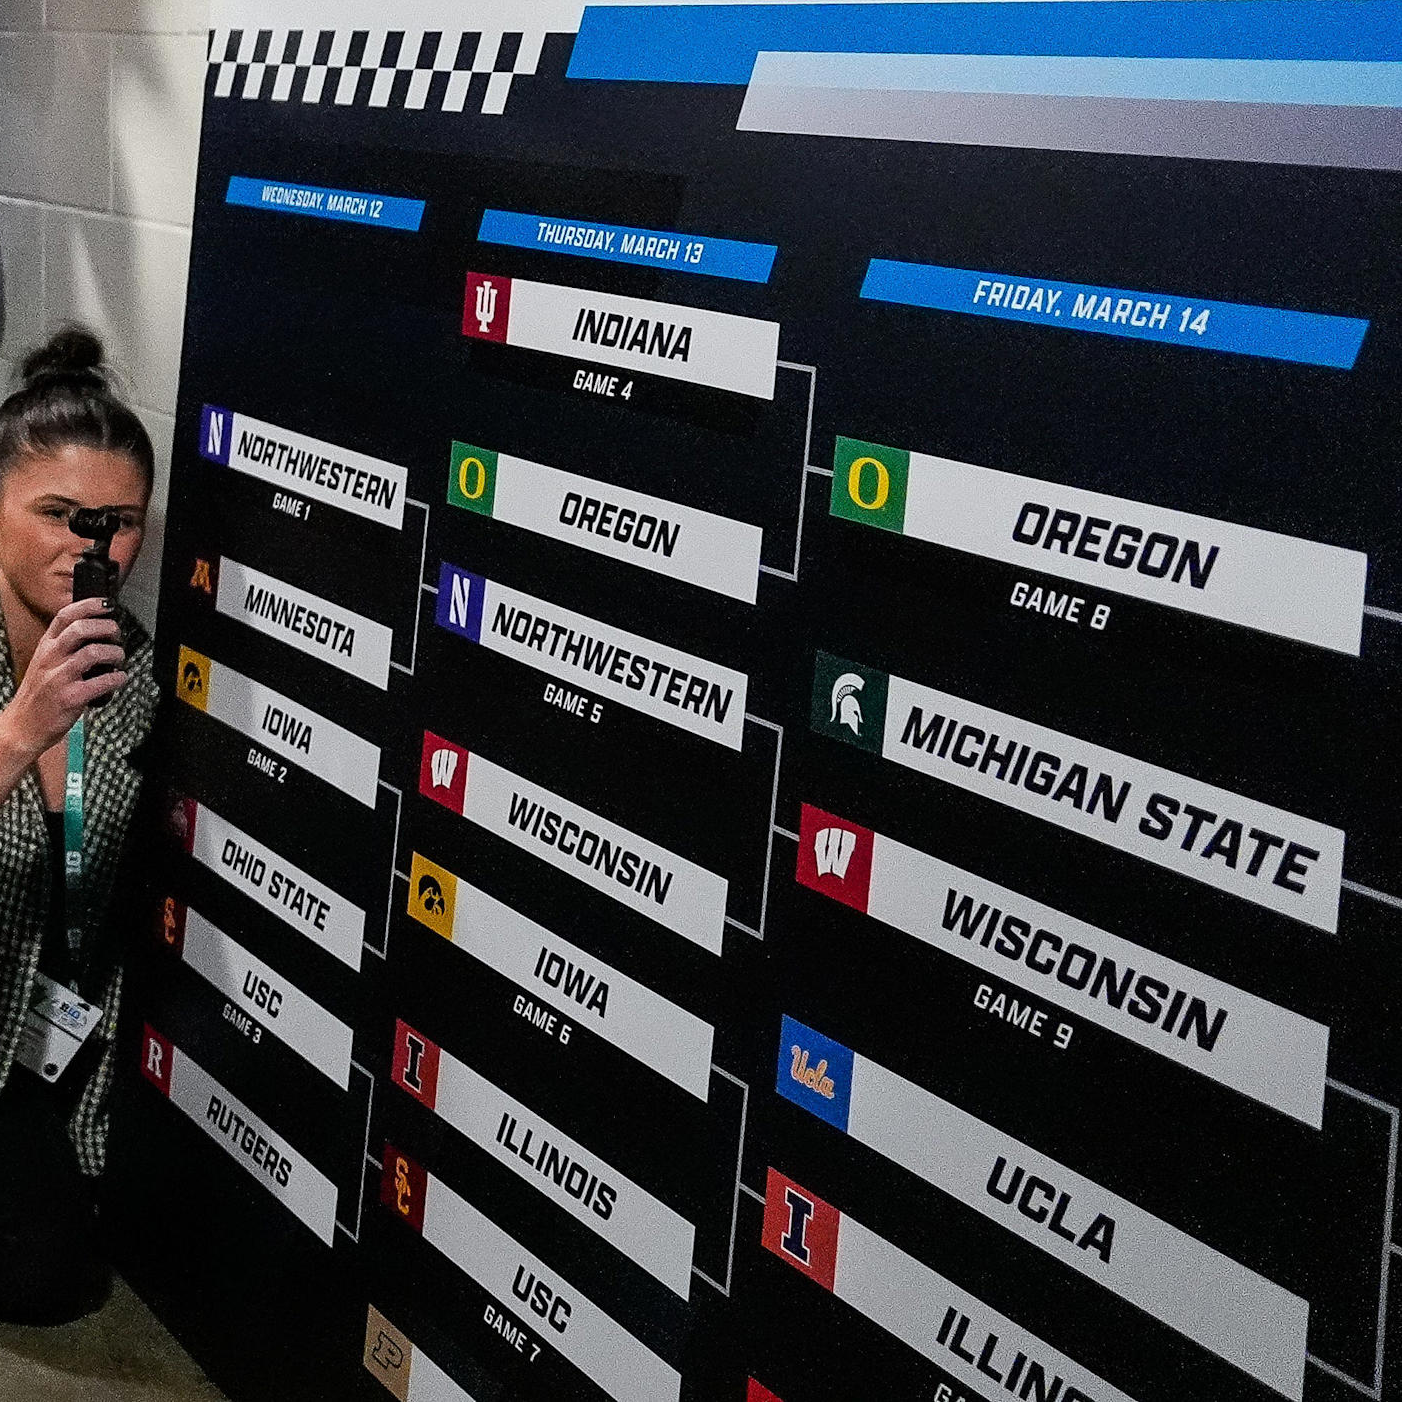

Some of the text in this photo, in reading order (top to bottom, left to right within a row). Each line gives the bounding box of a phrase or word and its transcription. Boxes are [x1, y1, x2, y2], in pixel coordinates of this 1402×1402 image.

[261, 185, 383, 218] WEDNESDAY, MARCH 12
[536, 223, 704, 264] THURSDAY, MARCH 13
[572, 308, 692, 362] INDIANA
[973, 279, 1211, 336] FRIDAY, MARCH 14
[573, 369, 632, 400] GAME 4
[207, 412, 224, 456] N
[237, 430, 397, 511] NORTHWESTERN
[458, 457, 486, 500] O
[847, 457, 890, 510] O
[272, 492, 310, 522] GAME 1
[559, 491, 681, 558] OREGON
[1012, 501, 1220, 590] OREGON
[244, 583, 356, 659] MINNESOTA
[447, 572, 470, 628] N
[1010, 582, 1110, 631] GAME 8
[491, 602, 733, 725] NORTHWESTERN
[261, 702, 313, 756] IOWA
[543, 682, 603, 724] GAME 5
[247, 747, 287, 784] GAME 2
[429, 748, 458, 789] W
[900, 705, 1320, 895] MICHIGAN STATE
[507, 792, 674, 906] WISCONSIN
[814, 827, 856, 881] W
[221, 838, 331, 933] OHIO STATE
[242, 969, 283, 1020] USC
[532, 946, 610, 1020] IOWA
[940, 888, 1229, 1054] WISCONSIN
[222, 1001, 261, 1045] GAME 3
[513, 994, 572, 1046] GAME 6
[973, 984, 1074, 1050] GAME 9
[147, 1037, 164, 1079] R
[206, 1095, 292, 1189] RUTGERS
[495, 1112, 617, 1223] ILLINOIS
[986, 1156, 1117, 1265] UCLA
[511, 1263, 572, 1335] USC
[483, 1304, 541, 1363] GAME 7
